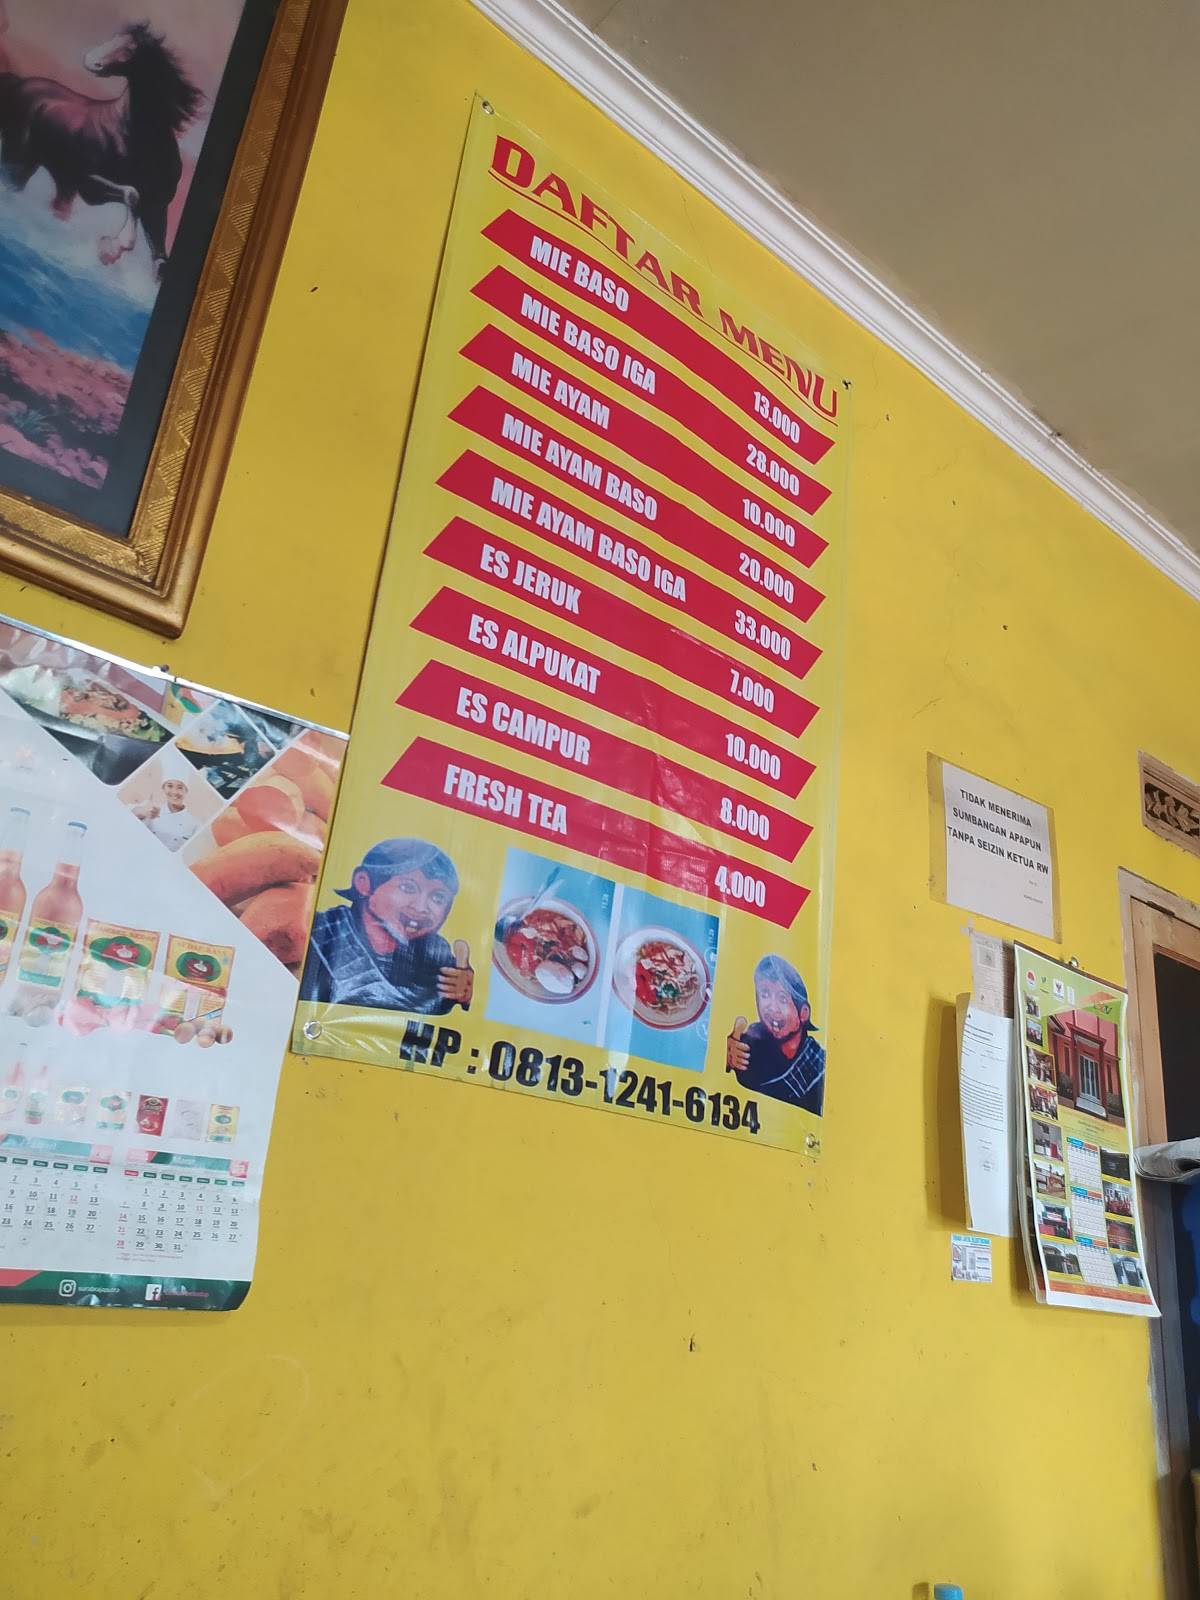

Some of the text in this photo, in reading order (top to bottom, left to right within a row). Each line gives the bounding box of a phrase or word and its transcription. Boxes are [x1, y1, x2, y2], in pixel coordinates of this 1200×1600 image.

[491, 135, 838, 418] DAFTAR MENU
[529, 235, 801, 444] MIE BASO 13.000
[511, 351, 796, 548] MIE AYAM 10.000
[520, 293, 800, 496] MIE BASO IGA 28.000
[490, 477, 791, 664] MIE AYAM BASO IGA 33.000
[501, 413, 795, 604] MIE AYAM BASO 20.000
[468, 613, 781, 780] ES ALPUKAT 10.000
[480, 543, 775, 713] ES JERUK 7.000
[443, 763, 766, 908] FRESH TEA 4.000
[455, 686, 770, 841] ES CAMPUR 8.000
[952, 807, 1042, 852] SUMBANGAN APAPUN
[959, 788, 1032, 828] TIDAK MENERIMA
[947, 825, 1049, 875] TANPA SEIZIN KETUA RW
[399, 1020, 761, 1135] HP : 0813-1241-6134
